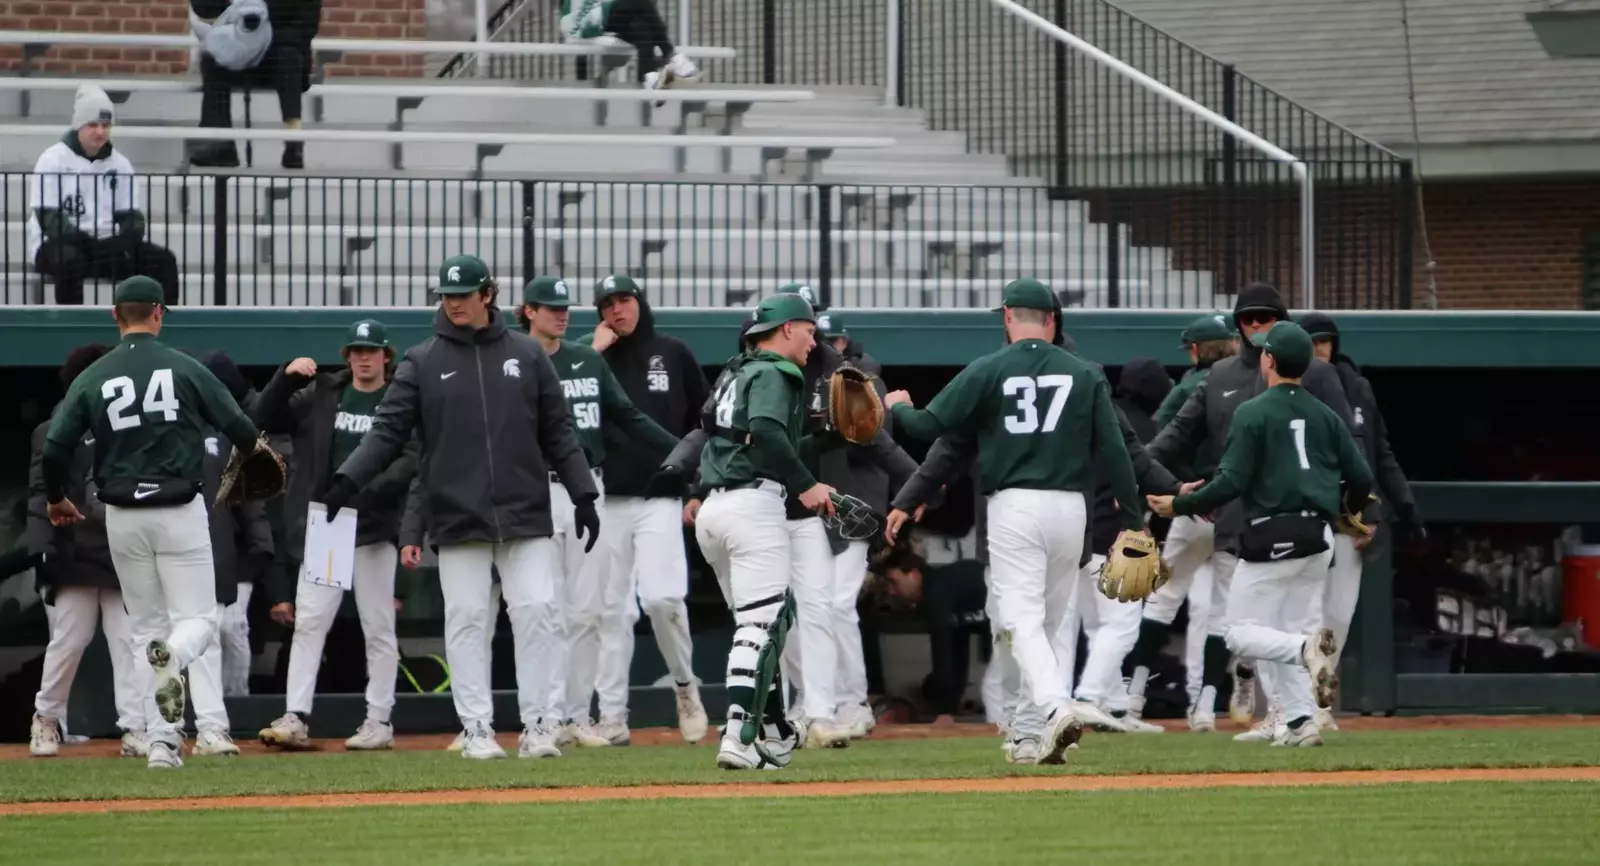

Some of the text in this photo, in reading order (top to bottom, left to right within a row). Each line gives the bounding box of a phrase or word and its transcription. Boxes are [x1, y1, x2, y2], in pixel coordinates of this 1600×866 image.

[101, 368, 180, 432] 24
[647, 374, 669, 391] 38
[1002, 374, 1073, 434] 37
[573, 402, 600, 429] 50
[1290, 418, 1310, 469] 1
